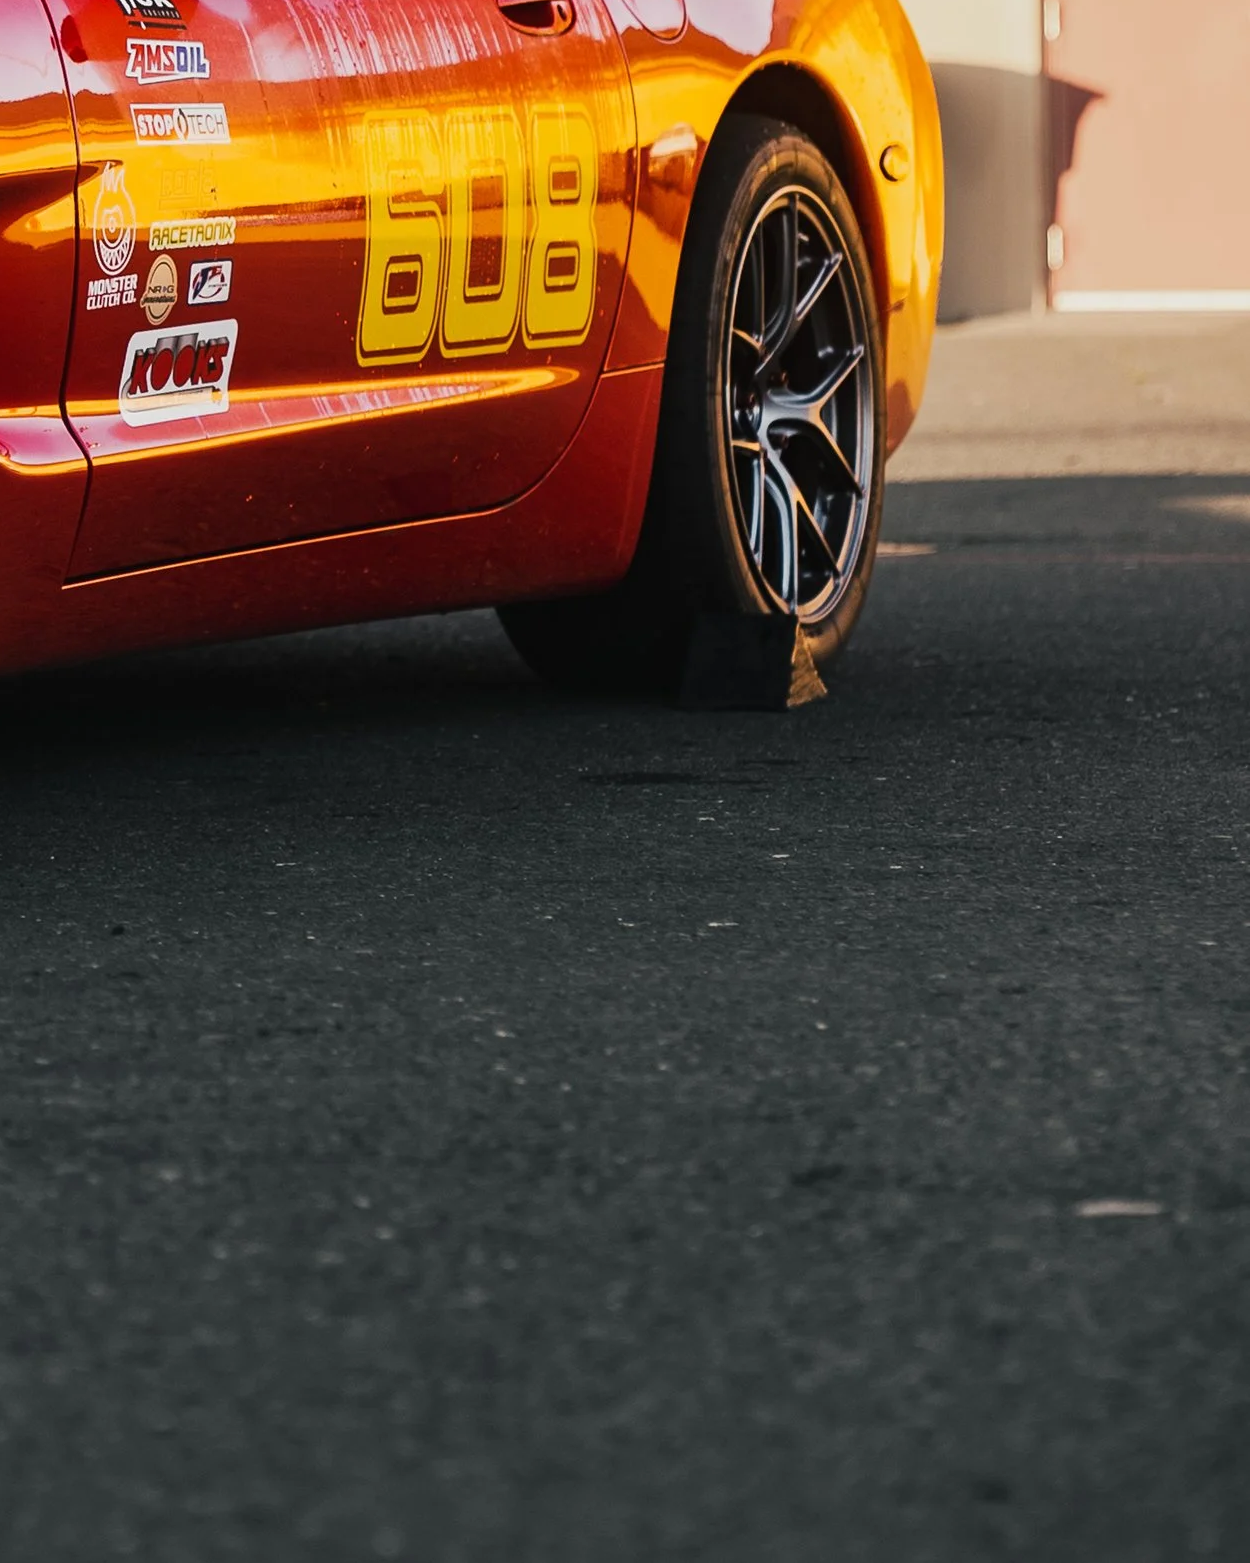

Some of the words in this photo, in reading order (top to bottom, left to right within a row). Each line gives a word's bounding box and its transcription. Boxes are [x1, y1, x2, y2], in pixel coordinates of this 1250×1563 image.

[130, 44, 206, 74] AMSOIL
[151, 222, 234, 246] RACETRONIX
[356, 103, 598, 367] 608
[88, 274, 138, 296] MONSTER
[86, 293, 121, 310] CLUTCH
[122, 290, 137, 304] CO.
[129, 337, 230, 396] KOOKS
